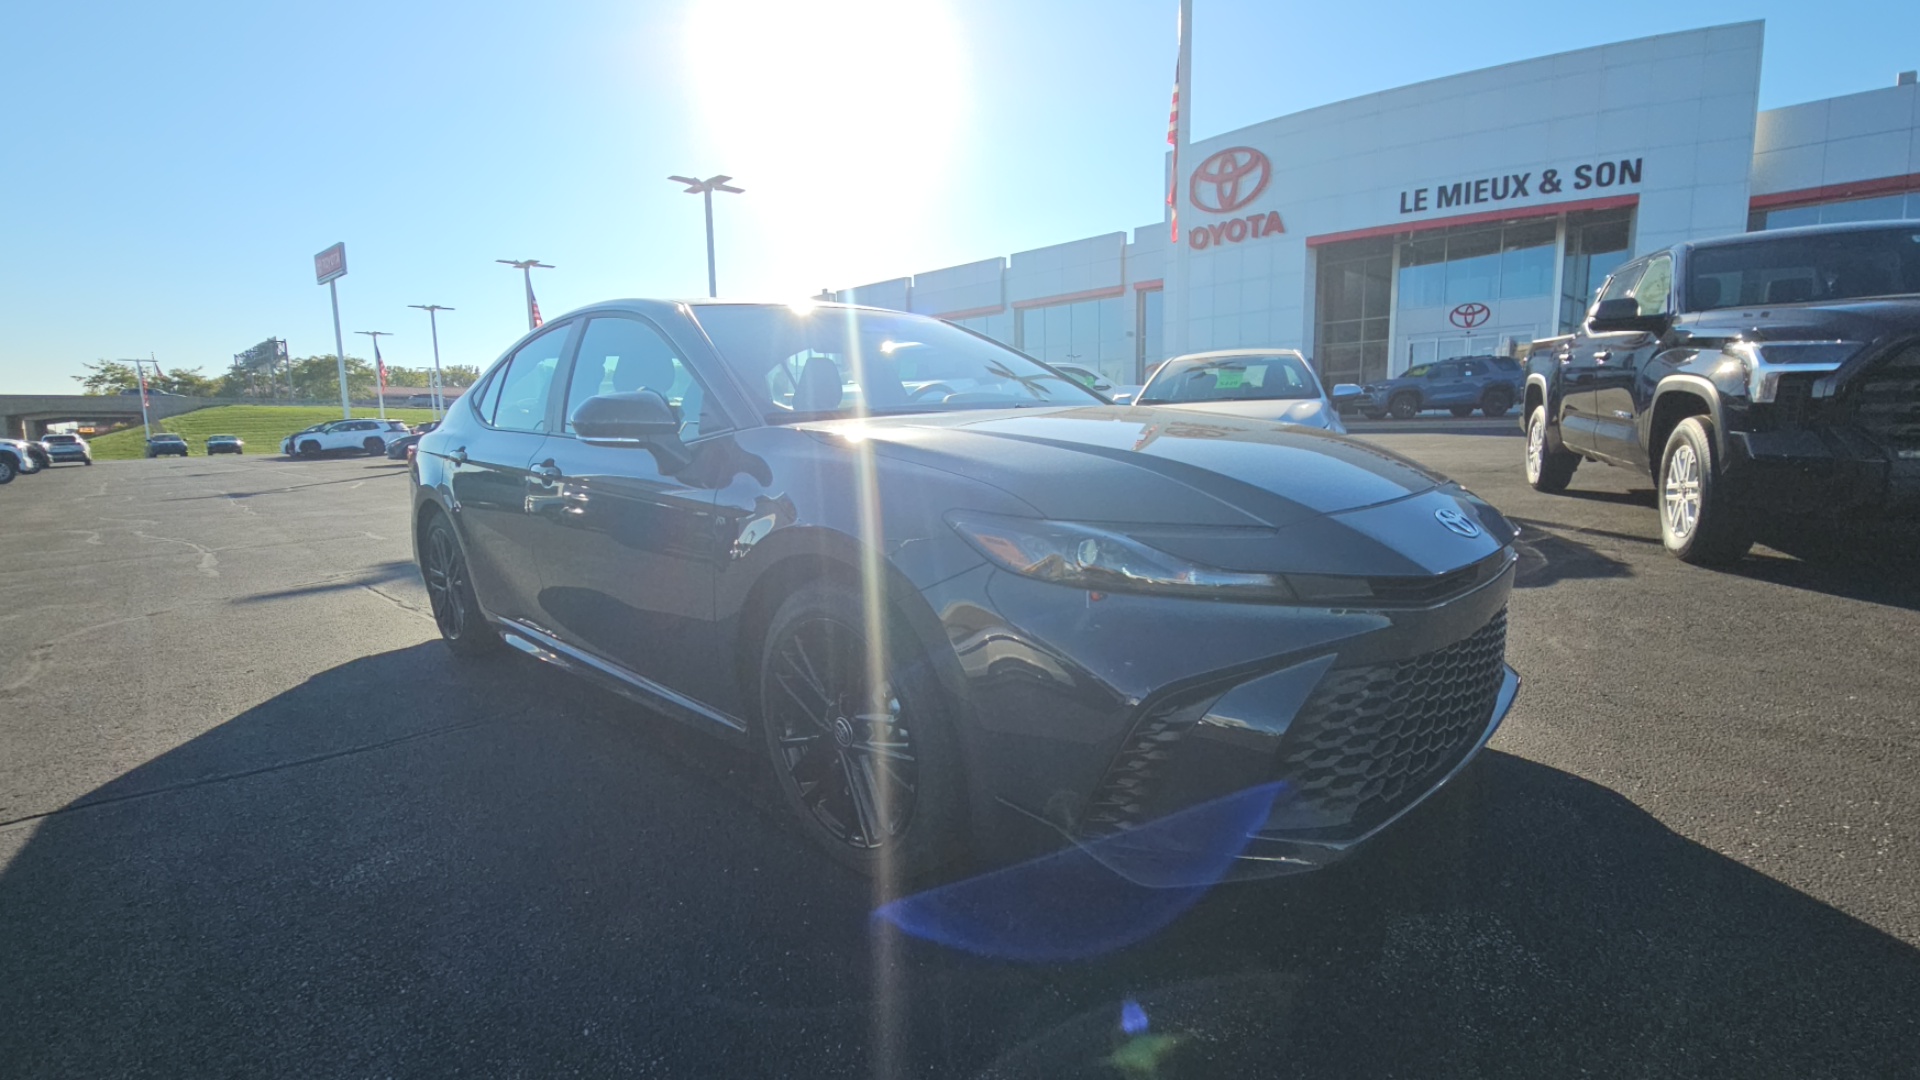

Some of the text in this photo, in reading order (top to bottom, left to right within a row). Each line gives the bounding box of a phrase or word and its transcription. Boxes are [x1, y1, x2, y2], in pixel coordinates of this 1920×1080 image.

[1400, 158, 1643, 213] LE MIEUX & SON
[1189, 211, 1286, 250] OYOTA
